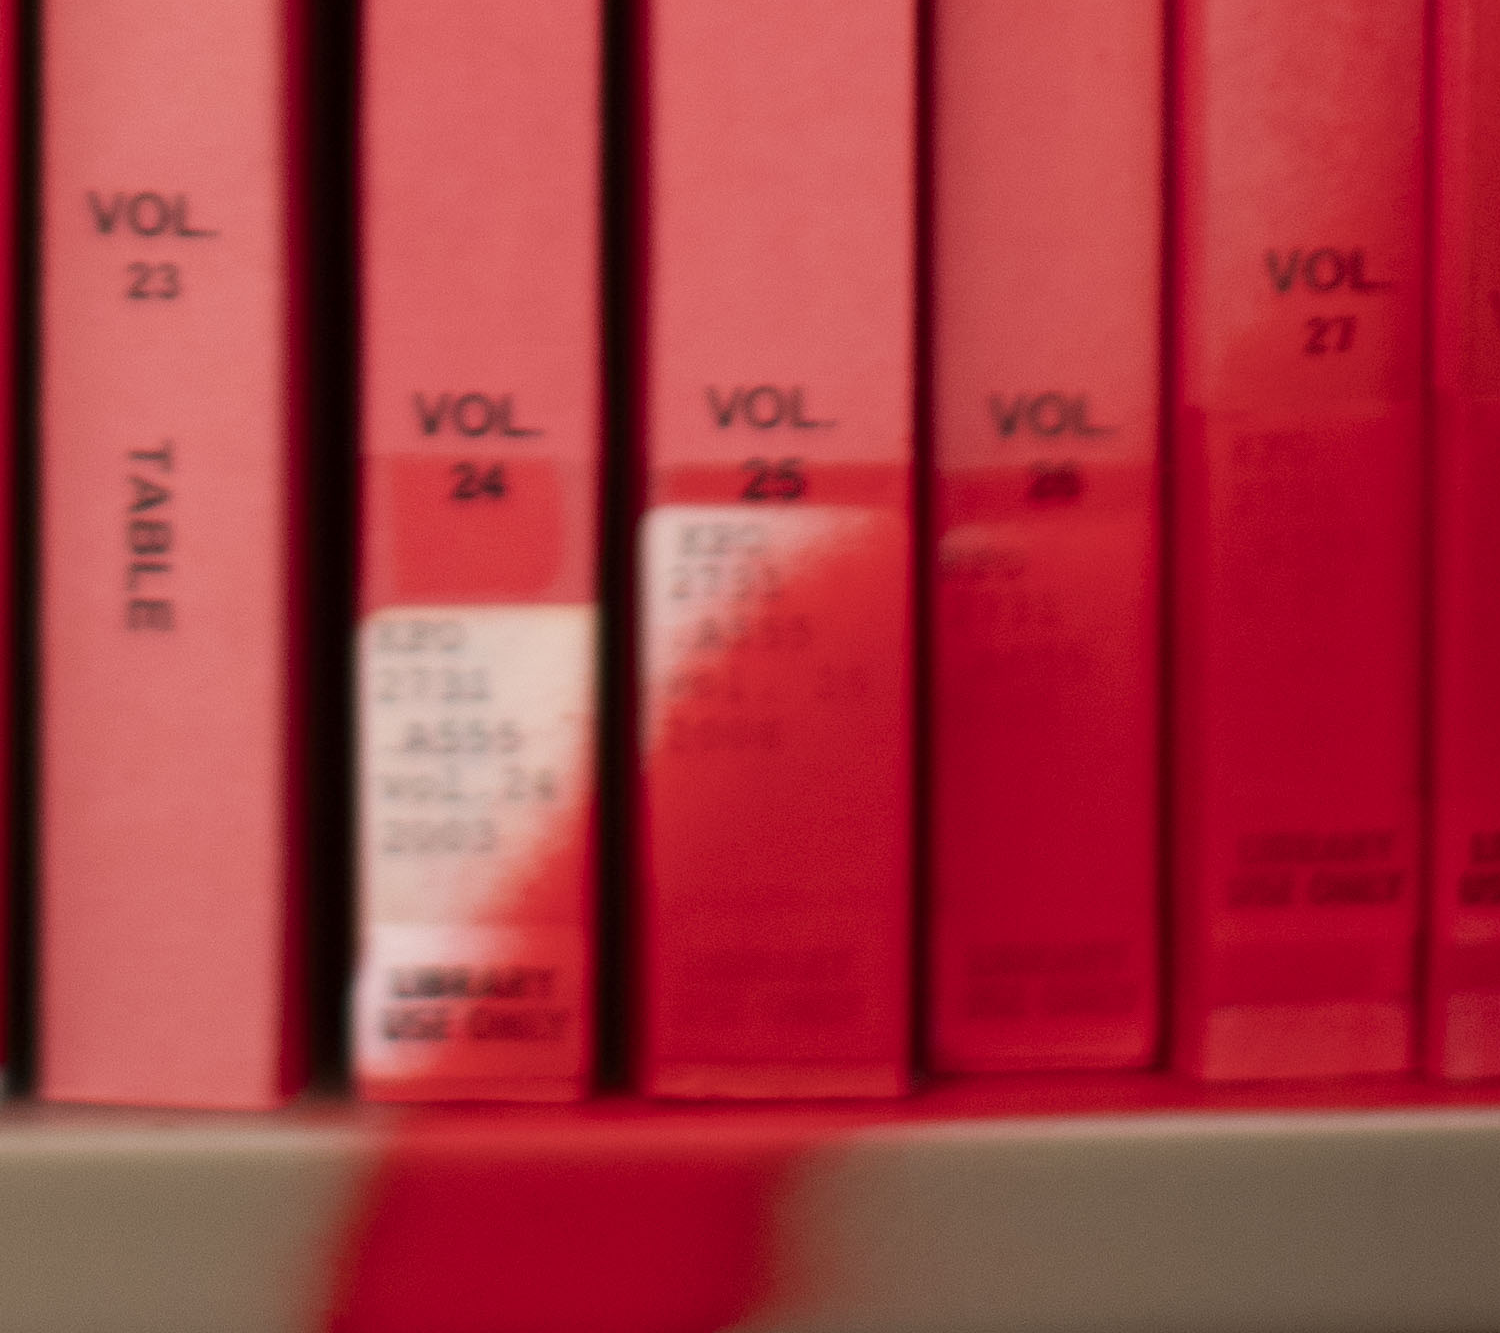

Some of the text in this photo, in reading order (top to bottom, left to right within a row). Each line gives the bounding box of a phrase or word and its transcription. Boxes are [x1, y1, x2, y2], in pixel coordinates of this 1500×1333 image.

[125, 262, 181, 300] 23
[1305, 315, 1359, 358] 27
[450, 463, 506, 503] 24
[738, 457, 805, 502] 25
[126, 440, 174, 632] TABLE
